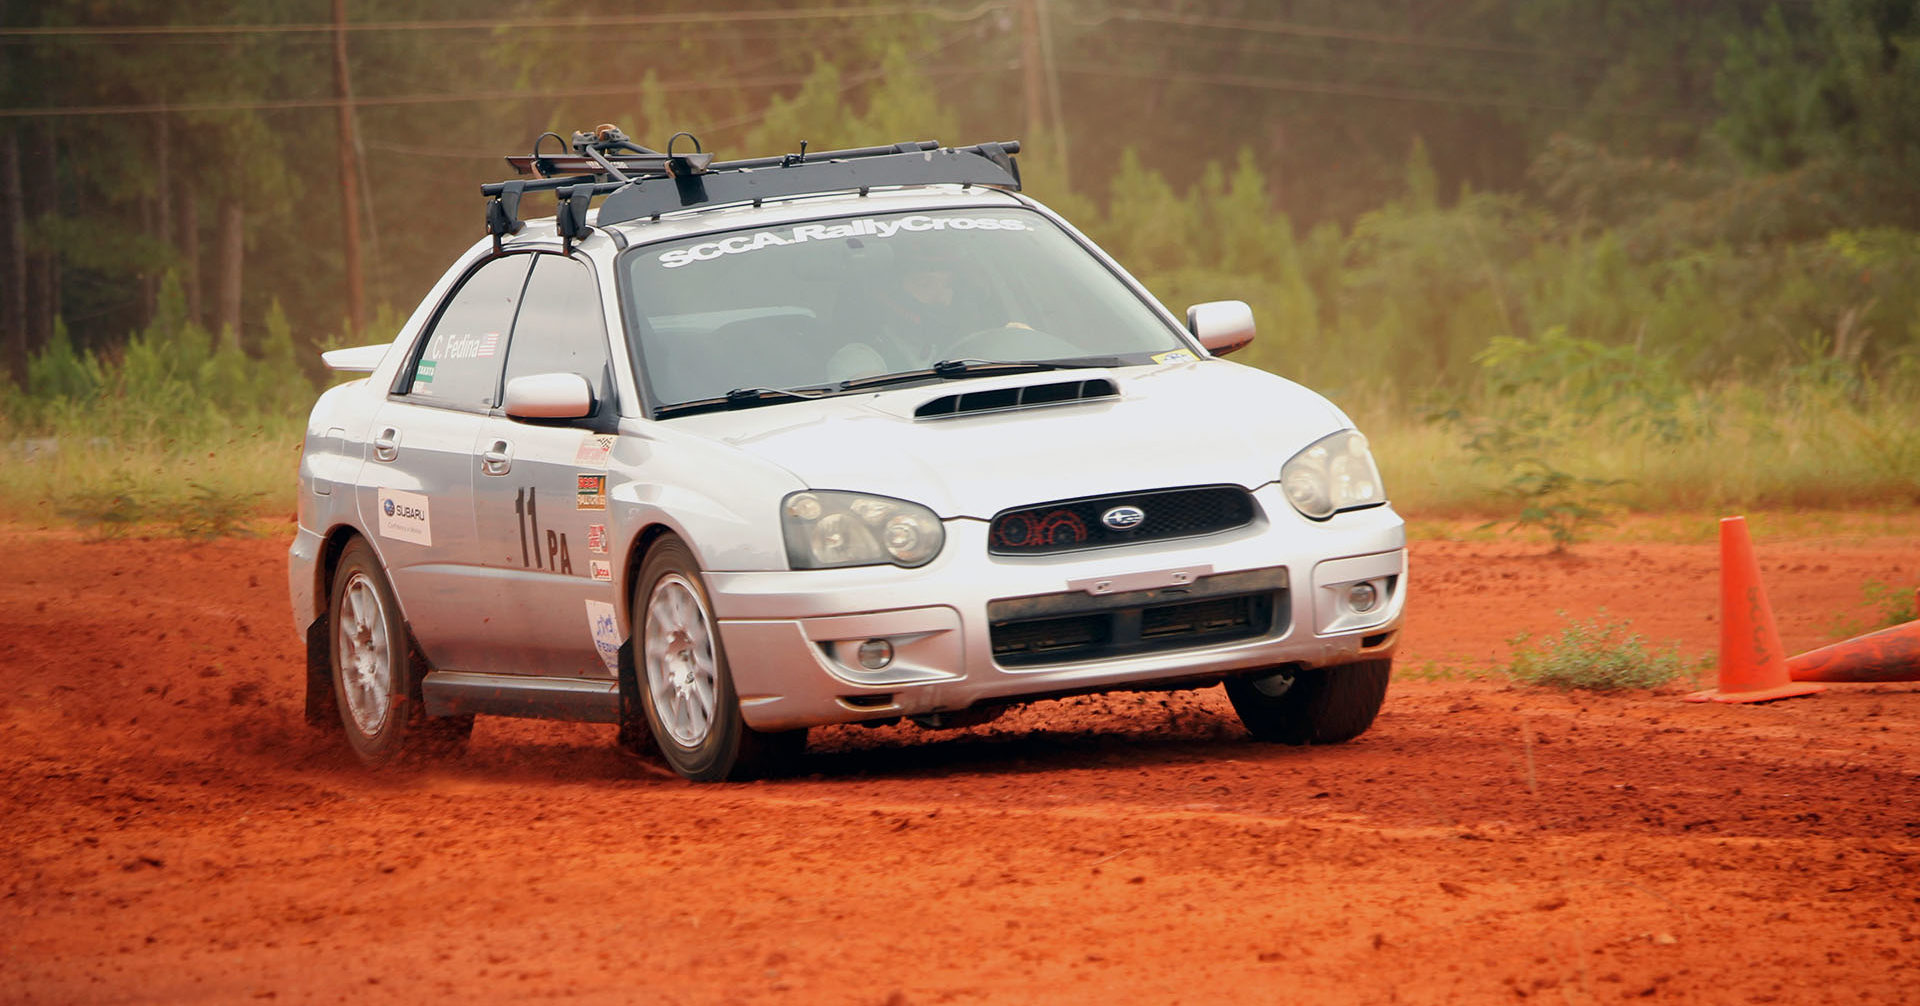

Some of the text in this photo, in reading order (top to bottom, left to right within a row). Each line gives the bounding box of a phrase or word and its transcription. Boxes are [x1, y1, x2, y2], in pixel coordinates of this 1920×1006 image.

[444, 333, 480, 359] Fedina
[396, 504, 425, 521] SUBARU
[515, 486, 573, 576] 11 PA
